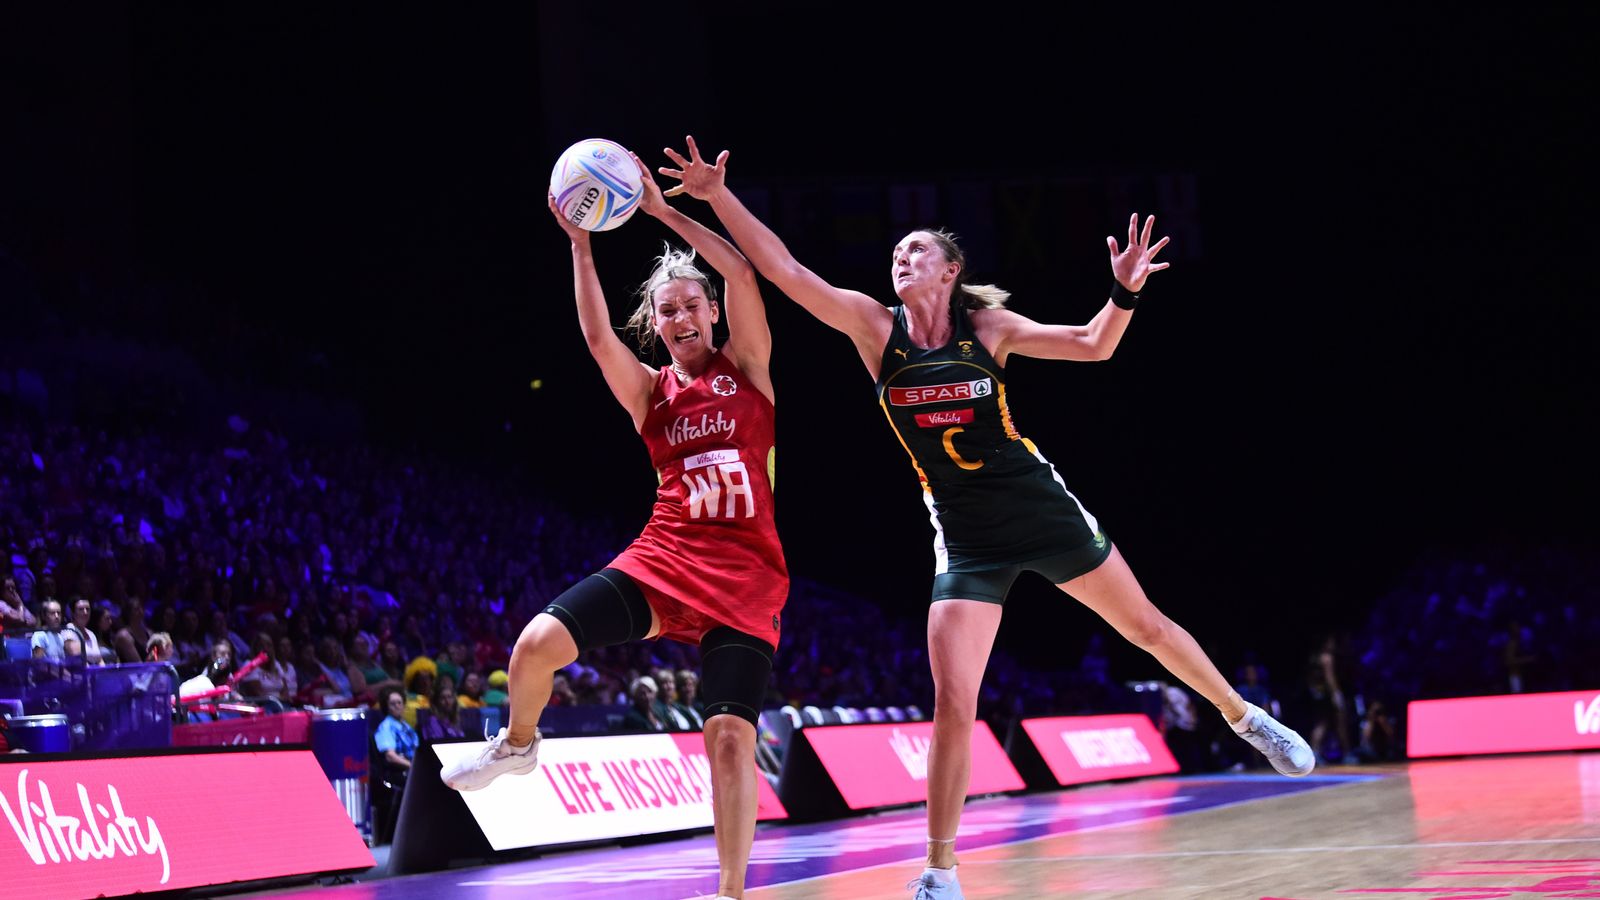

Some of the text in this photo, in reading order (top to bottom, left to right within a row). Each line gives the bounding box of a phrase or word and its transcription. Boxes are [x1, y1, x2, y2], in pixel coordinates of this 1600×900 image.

[571, 187, 600, 226] GILBE
[905, 385, 970, 402] SPAR
[664, 410, 736, 447] Vitality
[928, 412, 961, 424] Vitality
[696, 453, 726, 465] Vitality
[942, 426, 985, 470] C
[681, 461, 755, 519] WA
[541, 753, 714, 815] LIFE INSURA
[0, 769, 171, 885] Vitality
